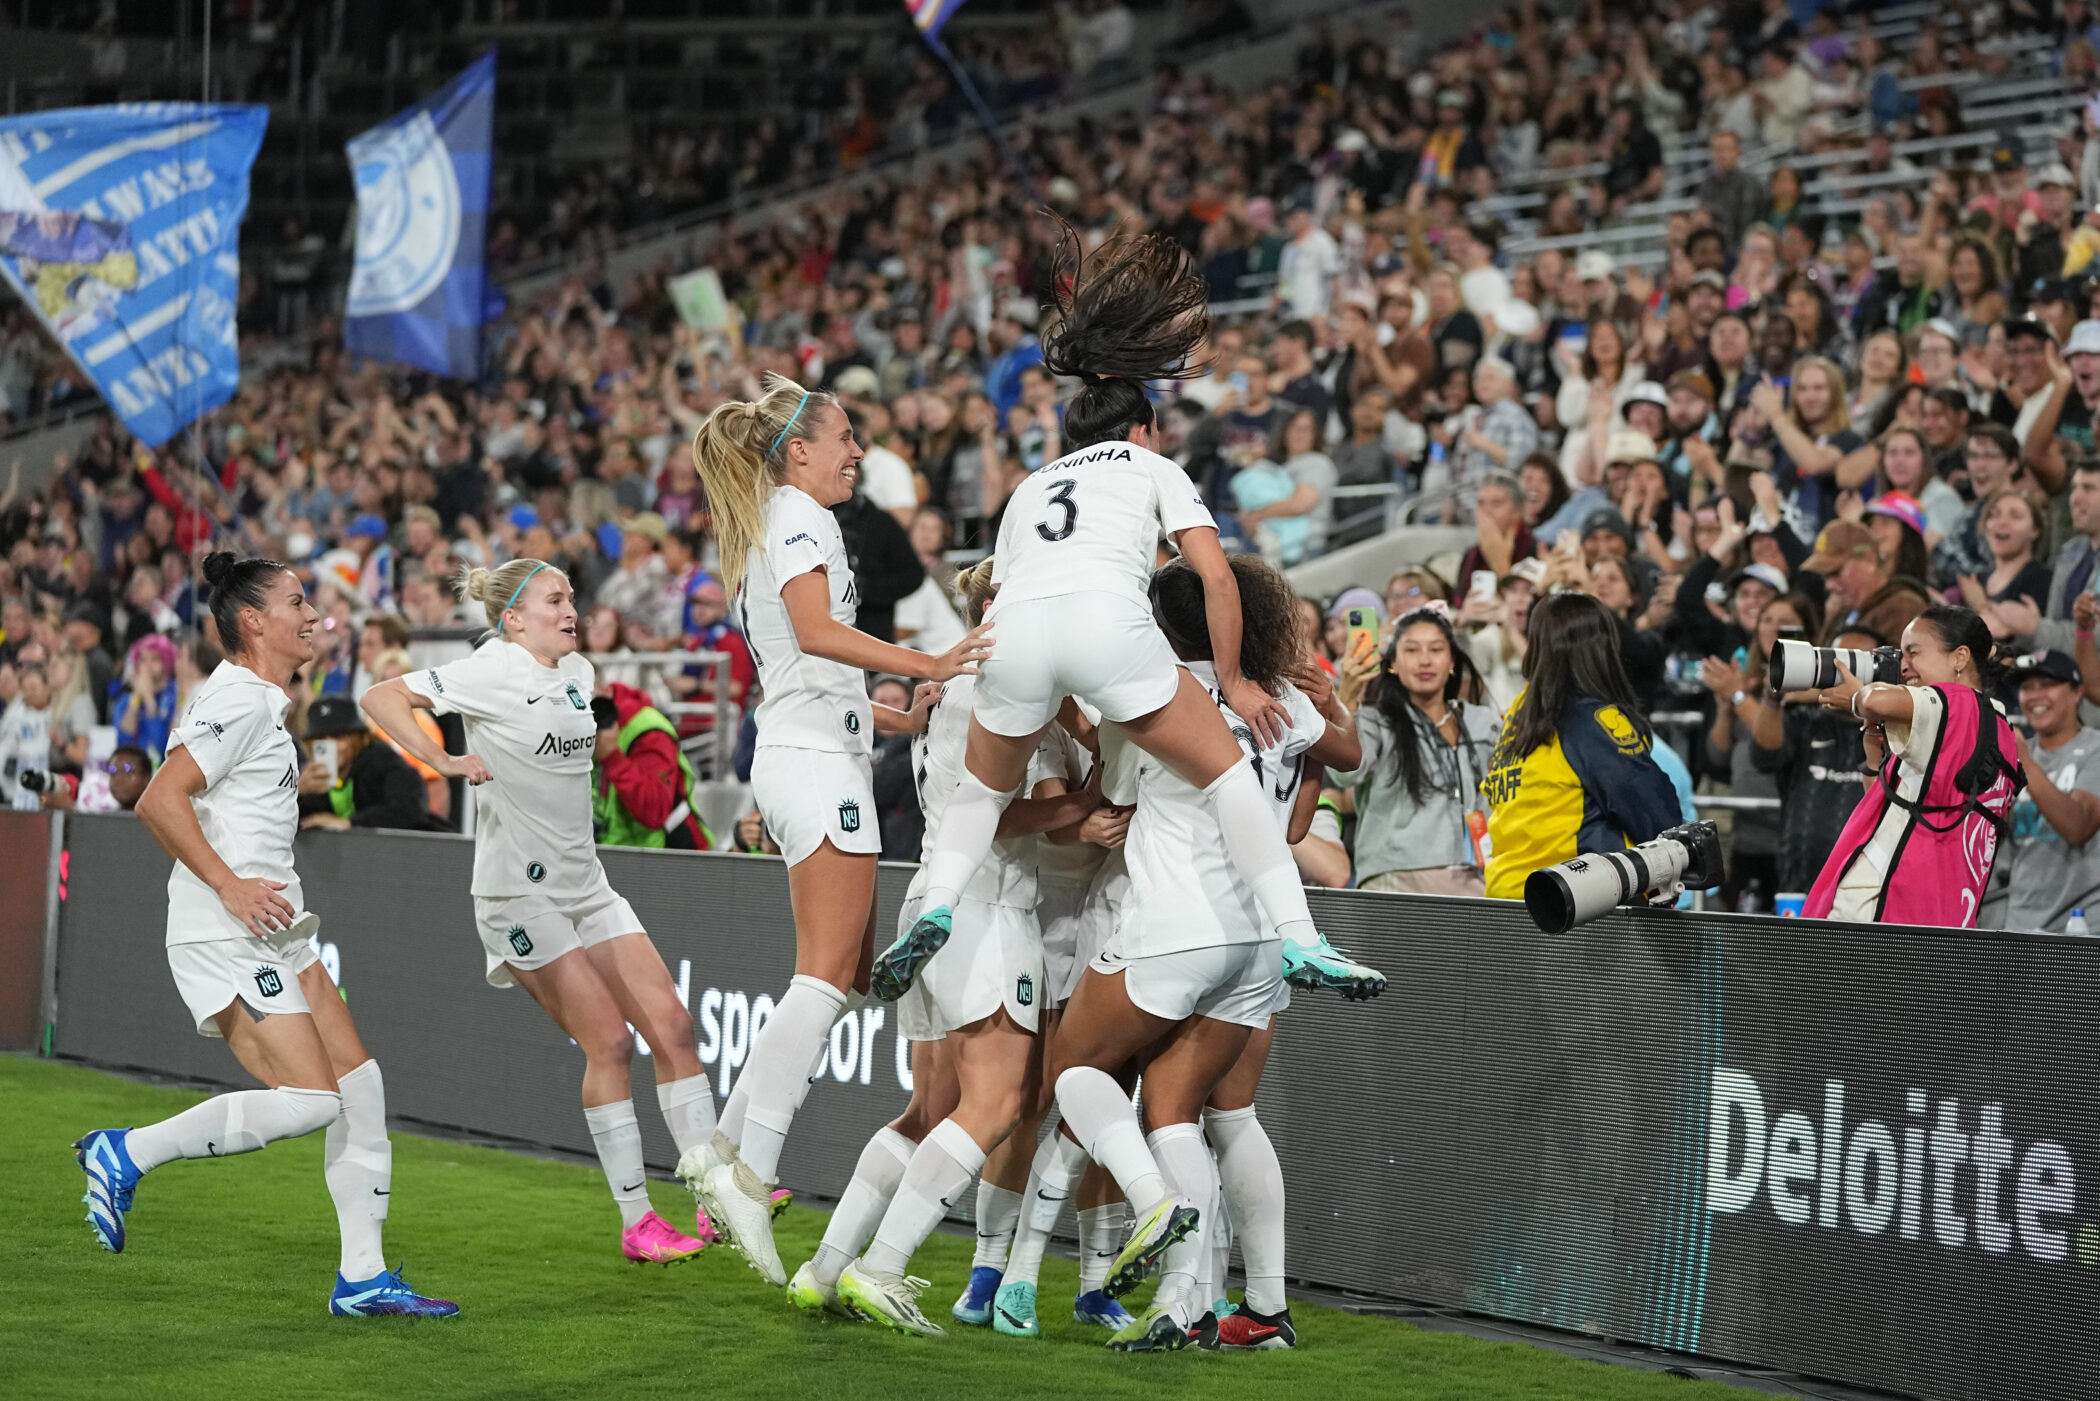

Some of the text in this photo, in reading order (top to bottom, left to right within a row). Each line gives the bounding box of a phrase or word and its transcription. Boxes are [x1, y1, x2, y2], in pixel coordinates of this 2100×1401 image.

[1032, 448, 1132, 477] UNINHA
[1035, 478, 1079, 542] 3
[842, 809, 858, 828] NY
[259, 973, 281, 995] NY
[698, 987, 885, 1098] spoor
